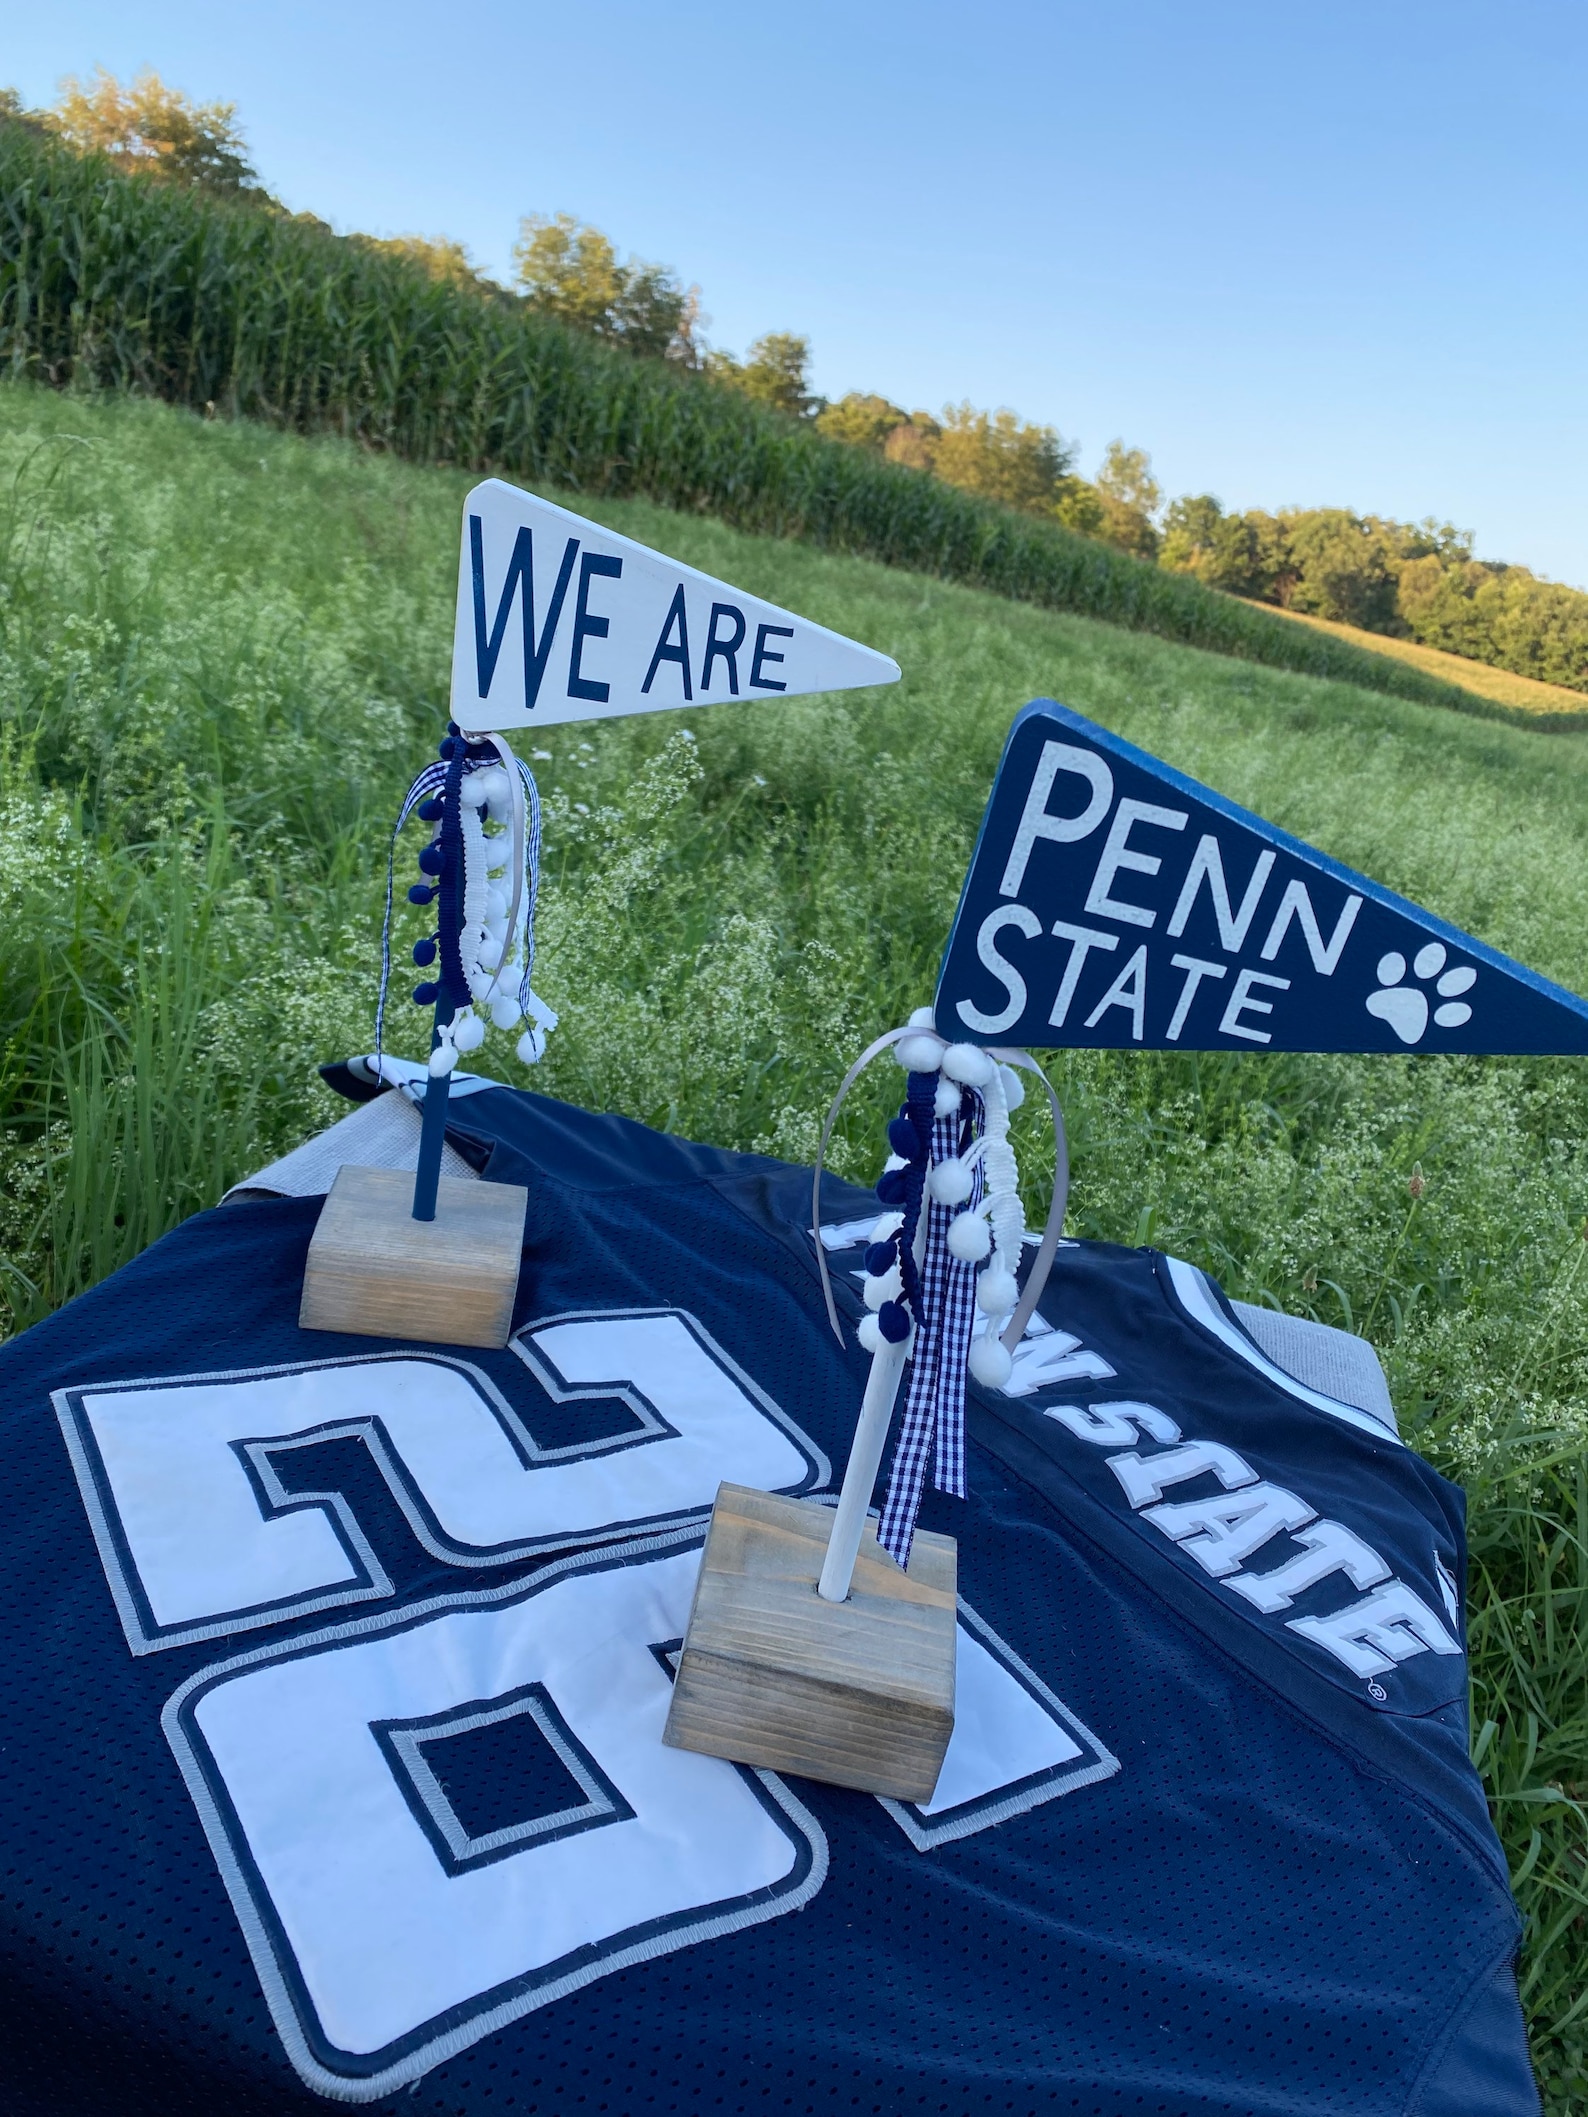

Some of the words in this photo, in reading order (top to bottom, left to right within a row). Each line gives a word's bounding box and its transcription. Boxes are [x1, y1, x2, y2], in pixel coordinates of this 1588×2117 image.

[469, 514, 623, 709] WE
[641, 583, 794, 700] ARE
[999, 739, 1363, 976] PENN
[955, 904, 1291, 1044] STATE
[1043, 1401, 1463, 1679] STATE
